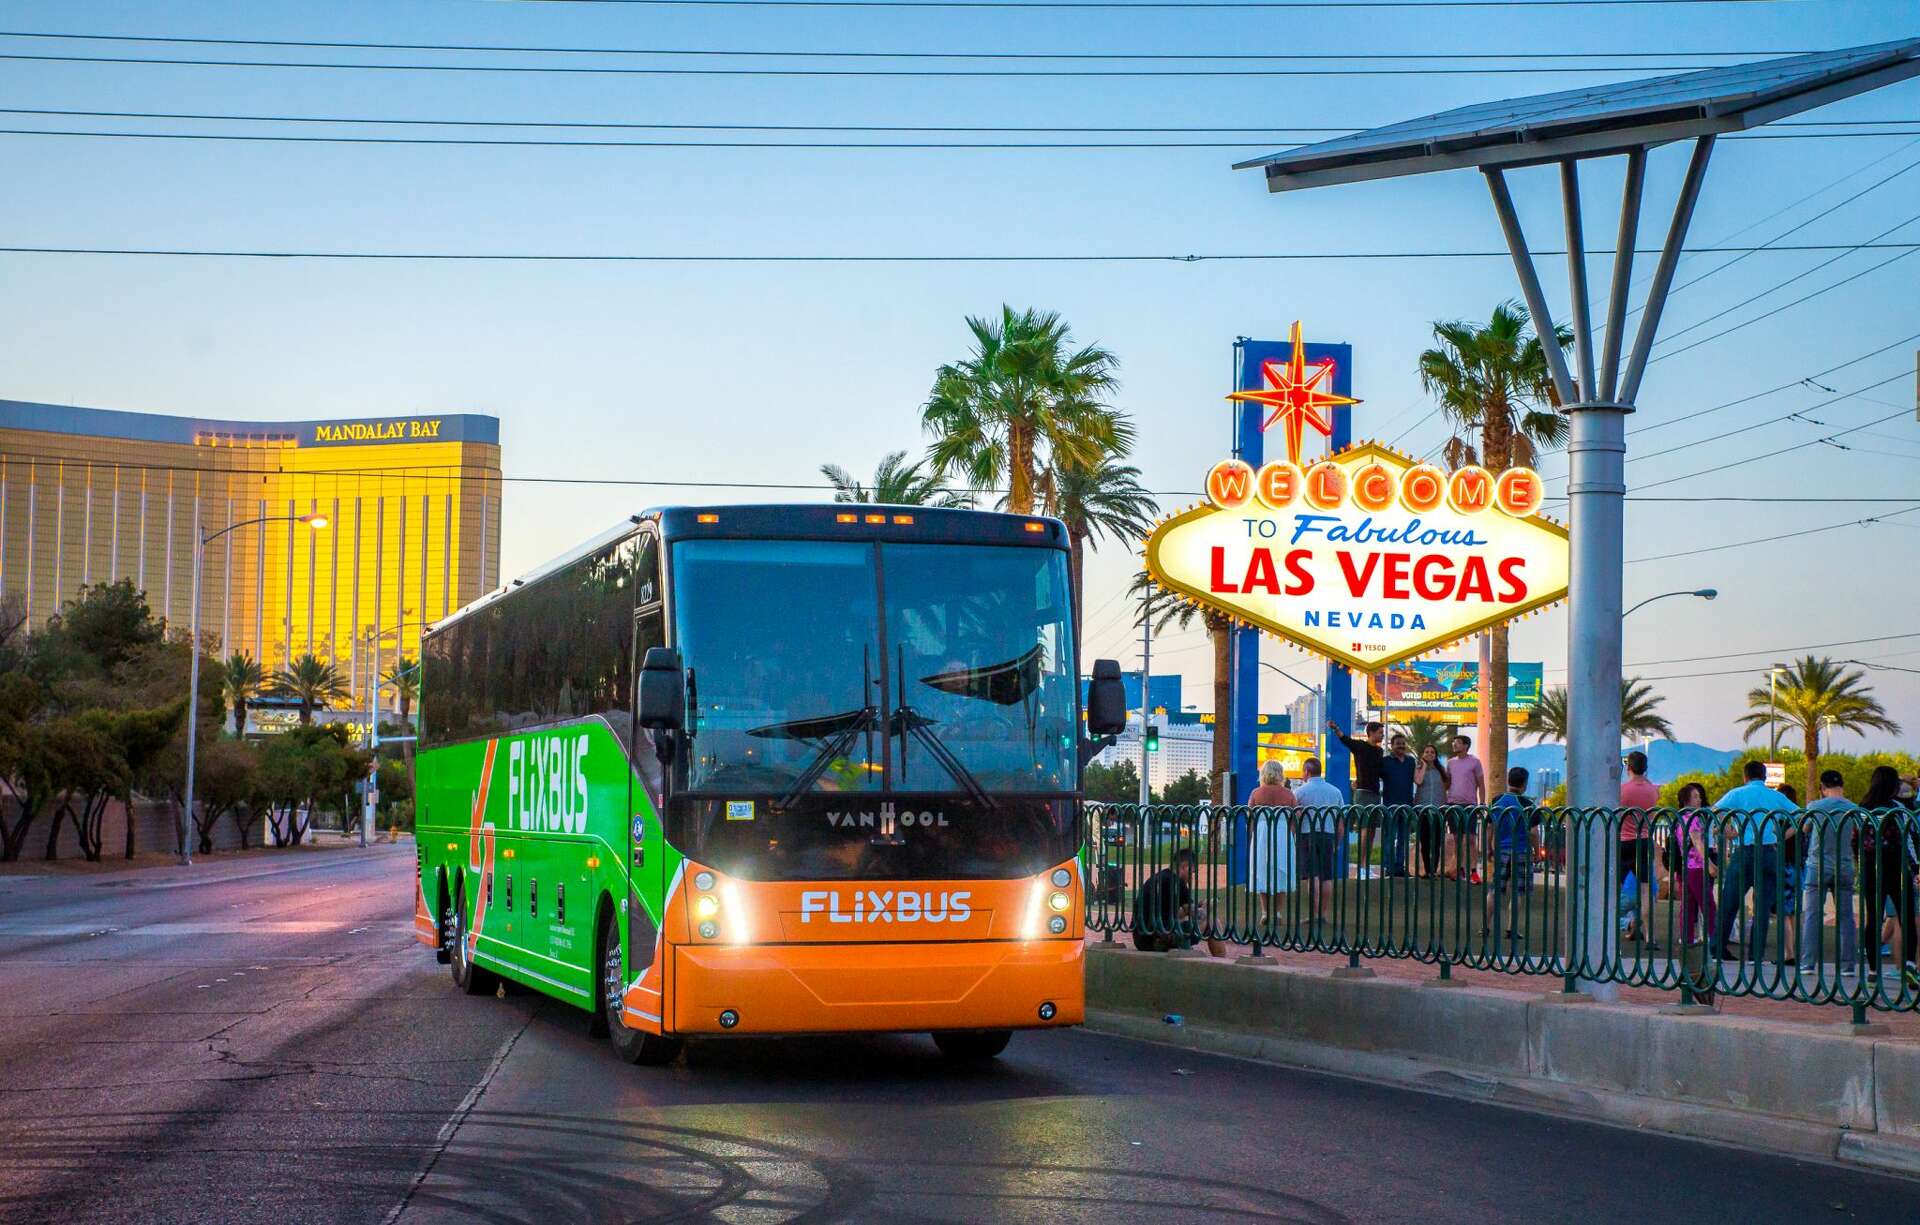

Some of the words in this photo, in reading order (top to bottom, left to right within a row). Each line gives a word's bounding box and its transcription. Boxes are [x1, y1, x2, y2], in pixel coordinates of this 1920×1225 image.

[315, 422, 407, 441] MANDALAY
[409, 420, 441, 437] BAY
[1213, 469, 1534, 510] WELCOME
[1242, 519, 1277, 538] TO
[1290, 514, 1488, 546] Fabulous
[1210, 546, 1315, 596] LAS
[1335, 551, 1529, 604] VEGAS
[1304, 610, 1427, 631] NEVADA
[1364, 643, 1387, 652] YESCO
